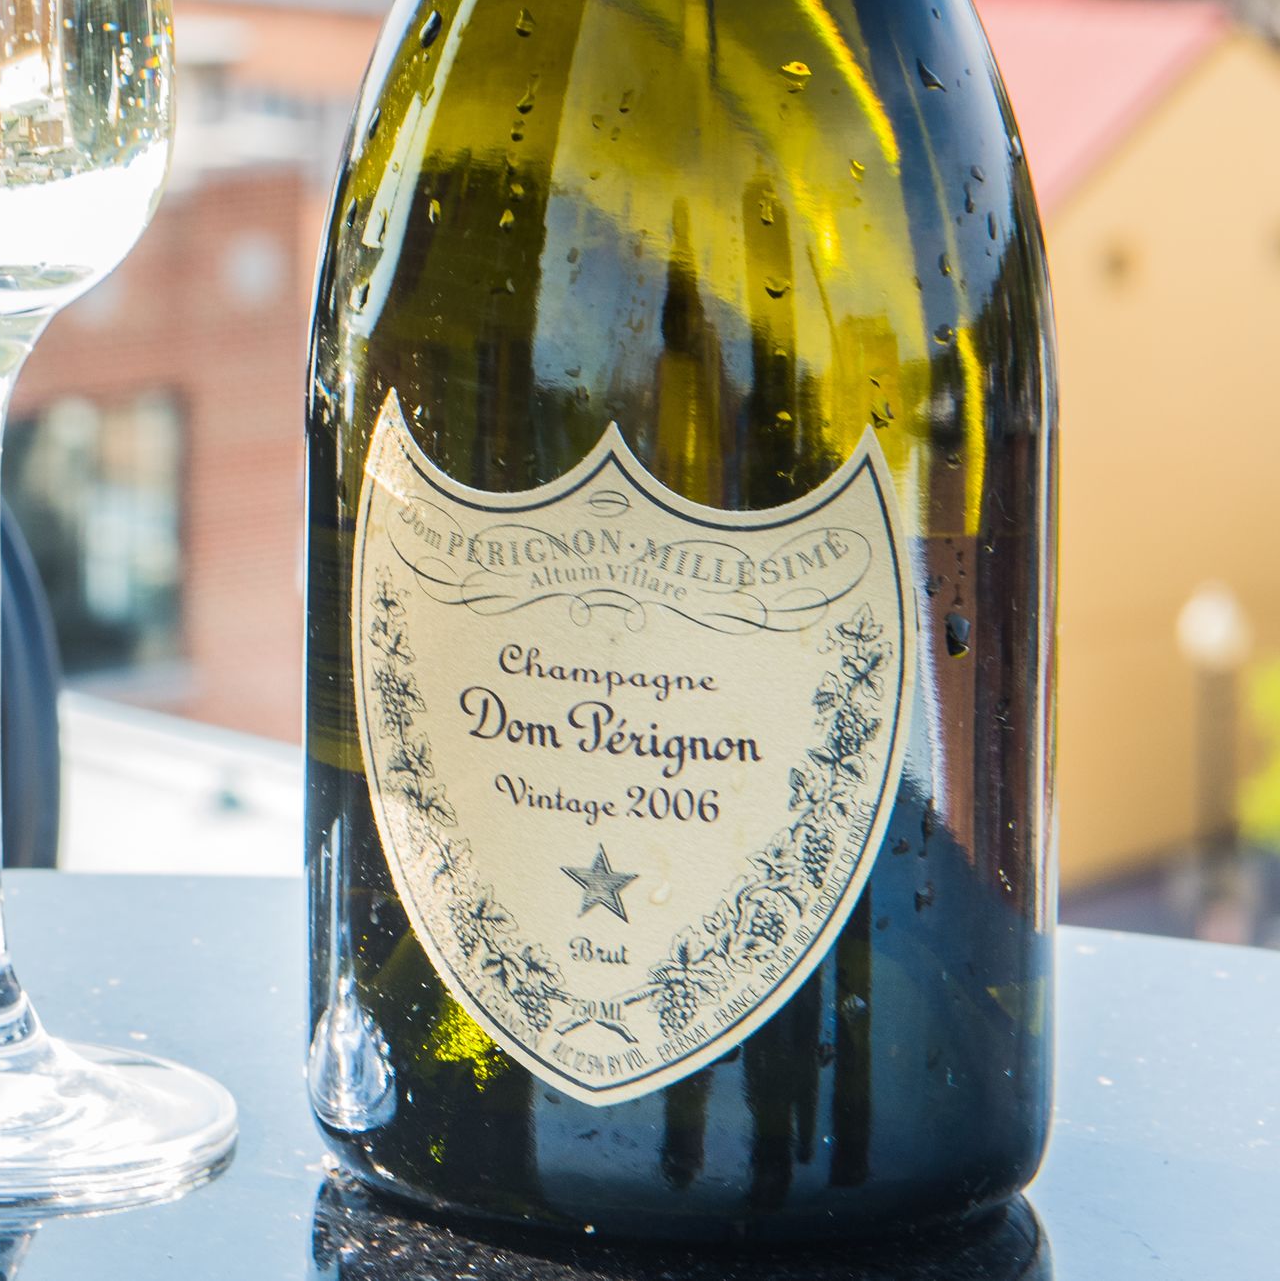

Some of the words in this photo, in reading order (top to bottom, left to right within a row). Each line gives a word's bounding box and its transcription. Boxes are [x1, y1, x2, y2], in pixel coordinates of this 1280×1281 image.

[530, 565, 601, 589] Altum
[498, 643, 720, 702] Champagne
[459, 686, 562, 749] Dom
[567, 701, 762, 779] Pérignon
[495, 774, 618, 826] Vintage
[626, 785, 721, 823] 2006
[569, 935, 630, 965] Brut
